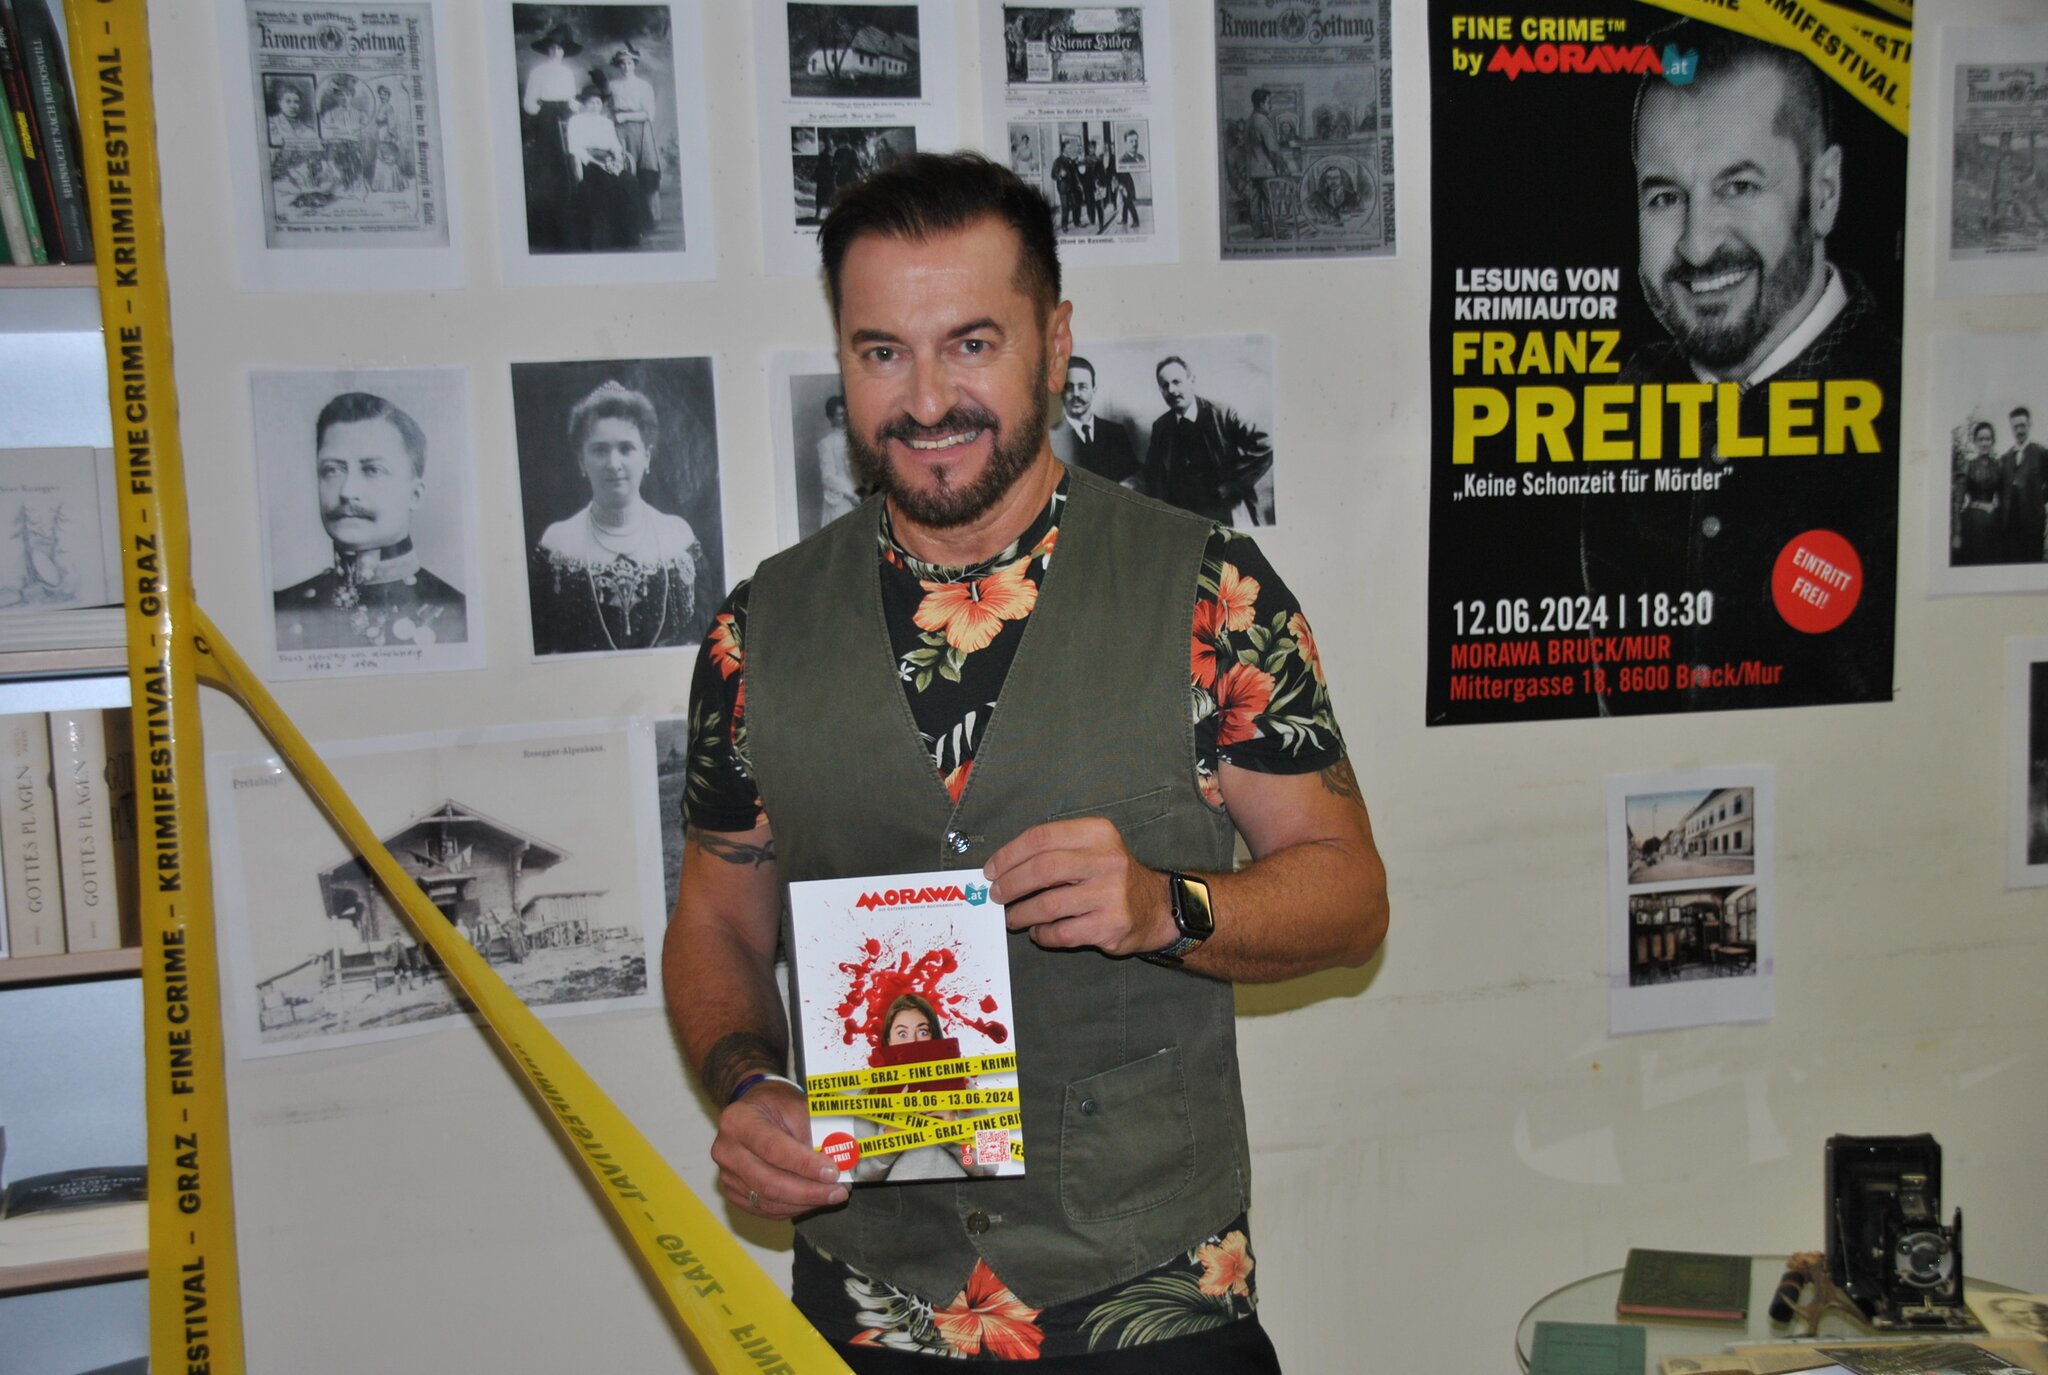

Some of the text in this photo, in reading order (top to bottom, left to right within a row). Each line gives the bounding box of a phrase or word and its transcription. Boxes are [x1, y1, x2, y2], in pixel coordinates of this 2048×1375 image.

[258, 23, 406, 56] Kronen Zeitung
[1051, 34, 1133, 52] Wiener Bilder
[1219, 8, 1374, 44] Kronen Zeitung
[1451, 16, 1512, 40] FINE
[1452, 47, 1484, 76] by
[98, 47, 138, 287] KRIMIFESTIVAL
[1455, 268, 1619, 293] LESUNG VON
[1454, 296, 1618, 321] KRIMIAUTOR
[120, 325, 148, 424] CRIME
[1452, 330, 1621, 375] FRANZ
[1452, 379, 1884, 465] PREITLER
[127, 429, 153, 495] FINE
[1522, 469, 1615, 497] Schonzeit
[1620, 468, 1649, 493] für
[135, 533, 162, 617] GRAZ
[1792, 547, 1853, 591] EINTRITT
[1453, 595, 1608, 636] 12.06.2024
[1637, 590, 1713, 627] 18:30
[1791, 577, 1830, 610] FREI!
[1451, 635, 1671, 669] MORAWA BRUCK/MUR
[1450, 661, 1783, 703] Mittergasse 18, 8600 Bruck/Mur
[74, 759, 94, 830] PLAGEN
[145, 659, 181, 893] KRIMIFESTIVAL
[16, 765, 43, 913] GOTTES PLAGEN
[80, 834, 99, 907] GOTTES
[163, 929, 190, 1024] CRIME
[169, 1029, 194, 1095] FINE
[871, 1070, 899, 1084] GRAZ
[909, 1066, 932, 1079] FINE
[935, 1061, 971, 1076] CRIME
[811, 1097, 893, 1111] KRIMIFESTIVAL
[904, 1095, 937, 1107] 08.06
[948, 1091, 1014, 1105] 13.06.2024
[935, 1124, 964, 1139] GRAZ
[973, 1118, 997, 1131] FINE
[175, 1132, 202, 1214] GRAZ
